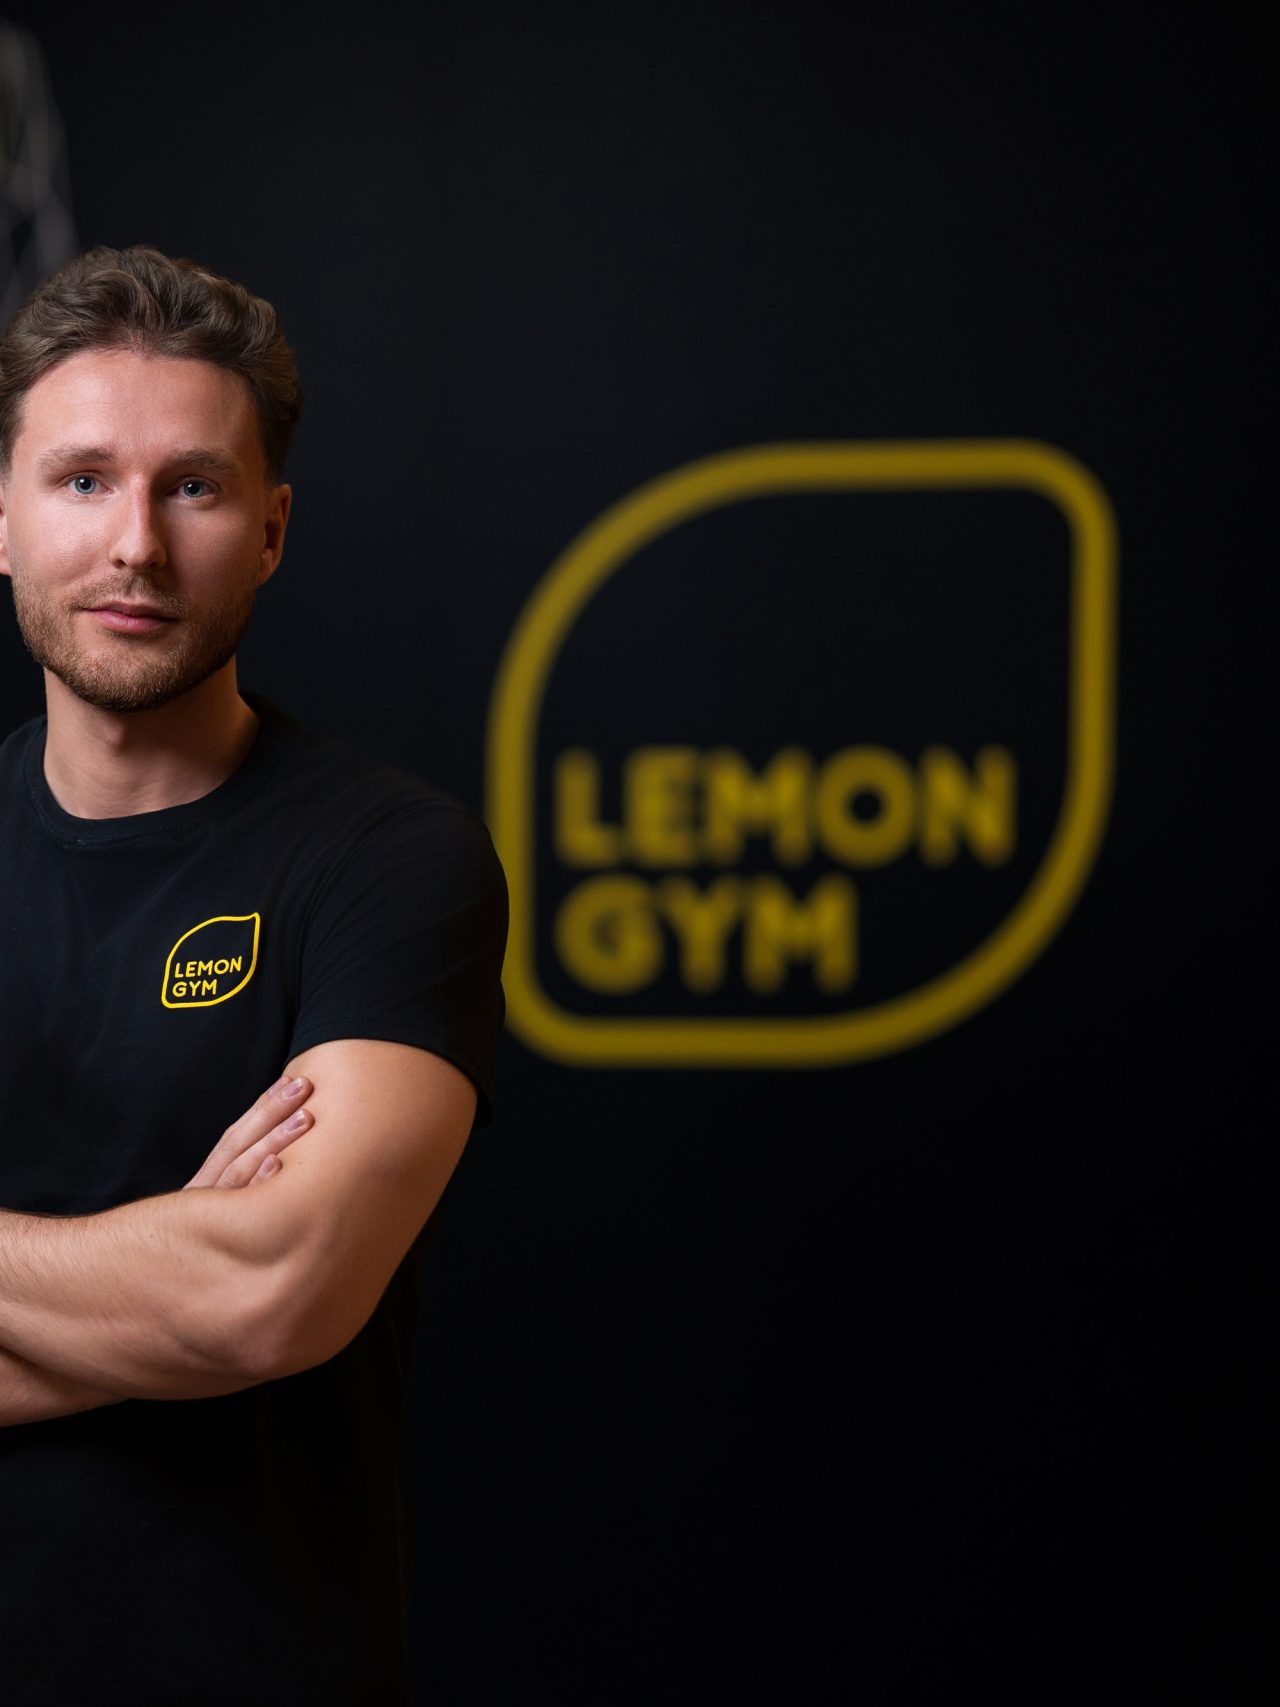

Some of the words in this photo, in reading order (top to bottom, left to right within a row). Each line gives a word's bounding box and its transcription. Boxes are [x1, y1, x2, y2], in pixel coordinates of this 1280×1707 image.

[556, 746, 1016, 868] LEMON
[174, 955, 243, 979] LEMON
[555, 874, 858, 992] GYM
[172, 979, 218, 998] GYM
